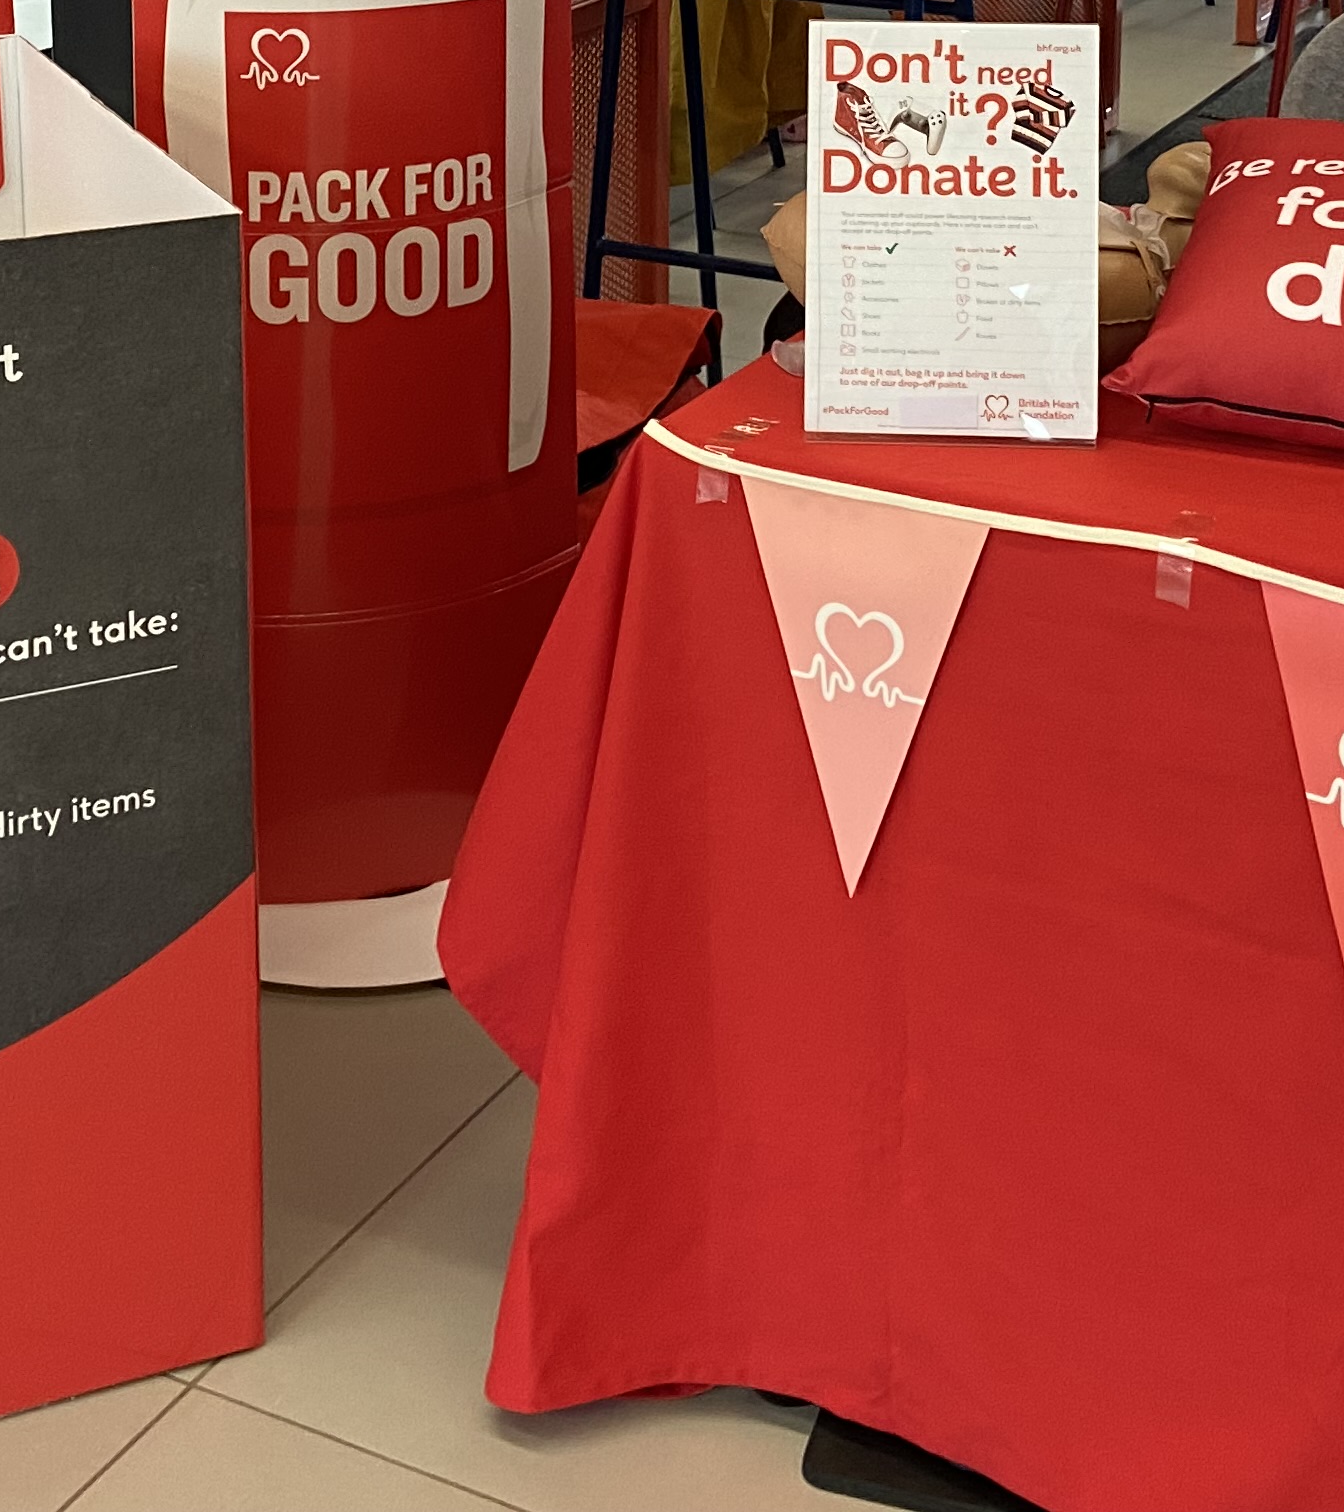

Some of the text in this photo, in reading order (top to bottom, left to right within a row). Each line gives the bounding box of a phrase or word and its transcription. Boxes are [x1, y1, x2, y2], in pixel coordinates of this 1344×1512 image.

[826, 39, 1053, 87] Don't need
[247, 152, 493, 224] PACK FOR
[822, 149, 1079, 199] Donate it.
[1209, 158, 1275, 196] Be
[249, 217, 494, 326] GOOD
[1018, 398, 1079, 409] British Heart
[88, 610, 181, 645] take:
[70, 783, 157, 828] items
